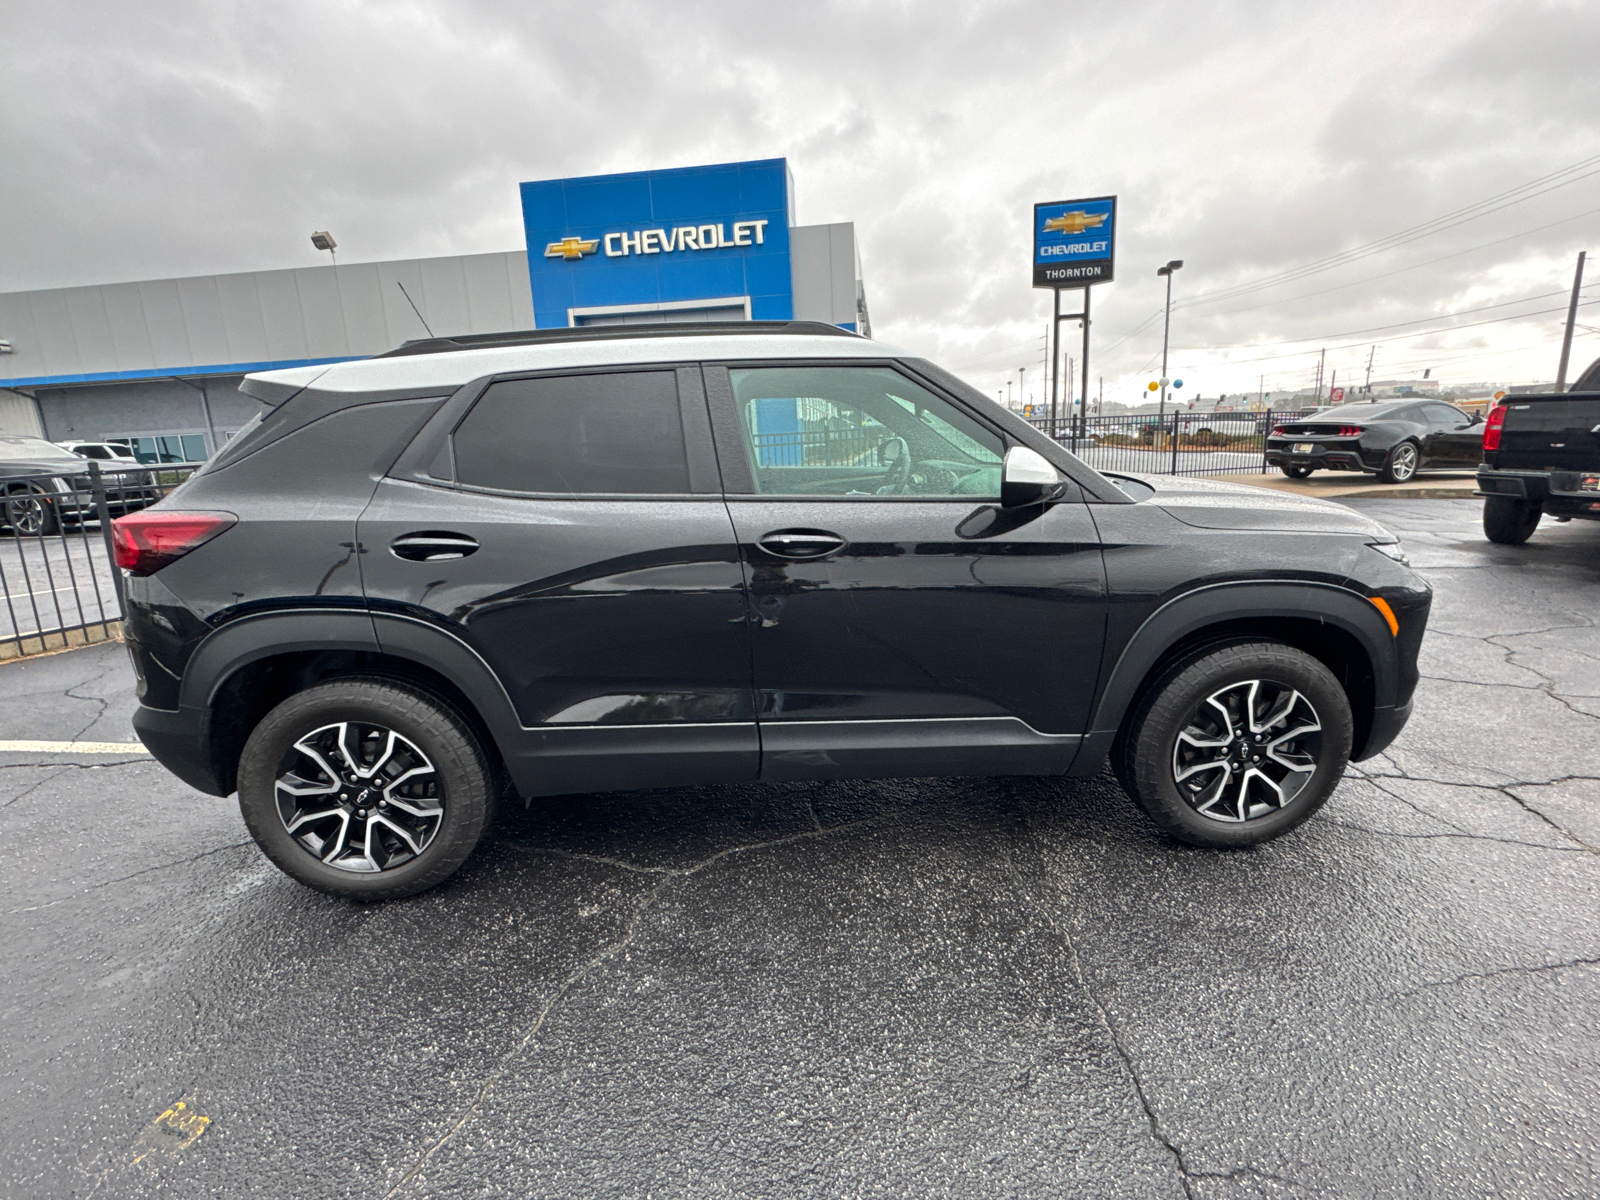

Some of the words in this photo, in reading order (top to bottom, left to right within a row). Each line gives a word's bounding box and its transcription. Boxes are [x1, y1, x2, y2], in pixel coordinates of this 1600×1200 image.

[604, 219, 768, 257] CHEVROLET
[1040, 241, 1108, 256] CHEVROLET
[1045, 266, 1101, 279] THORNTON
